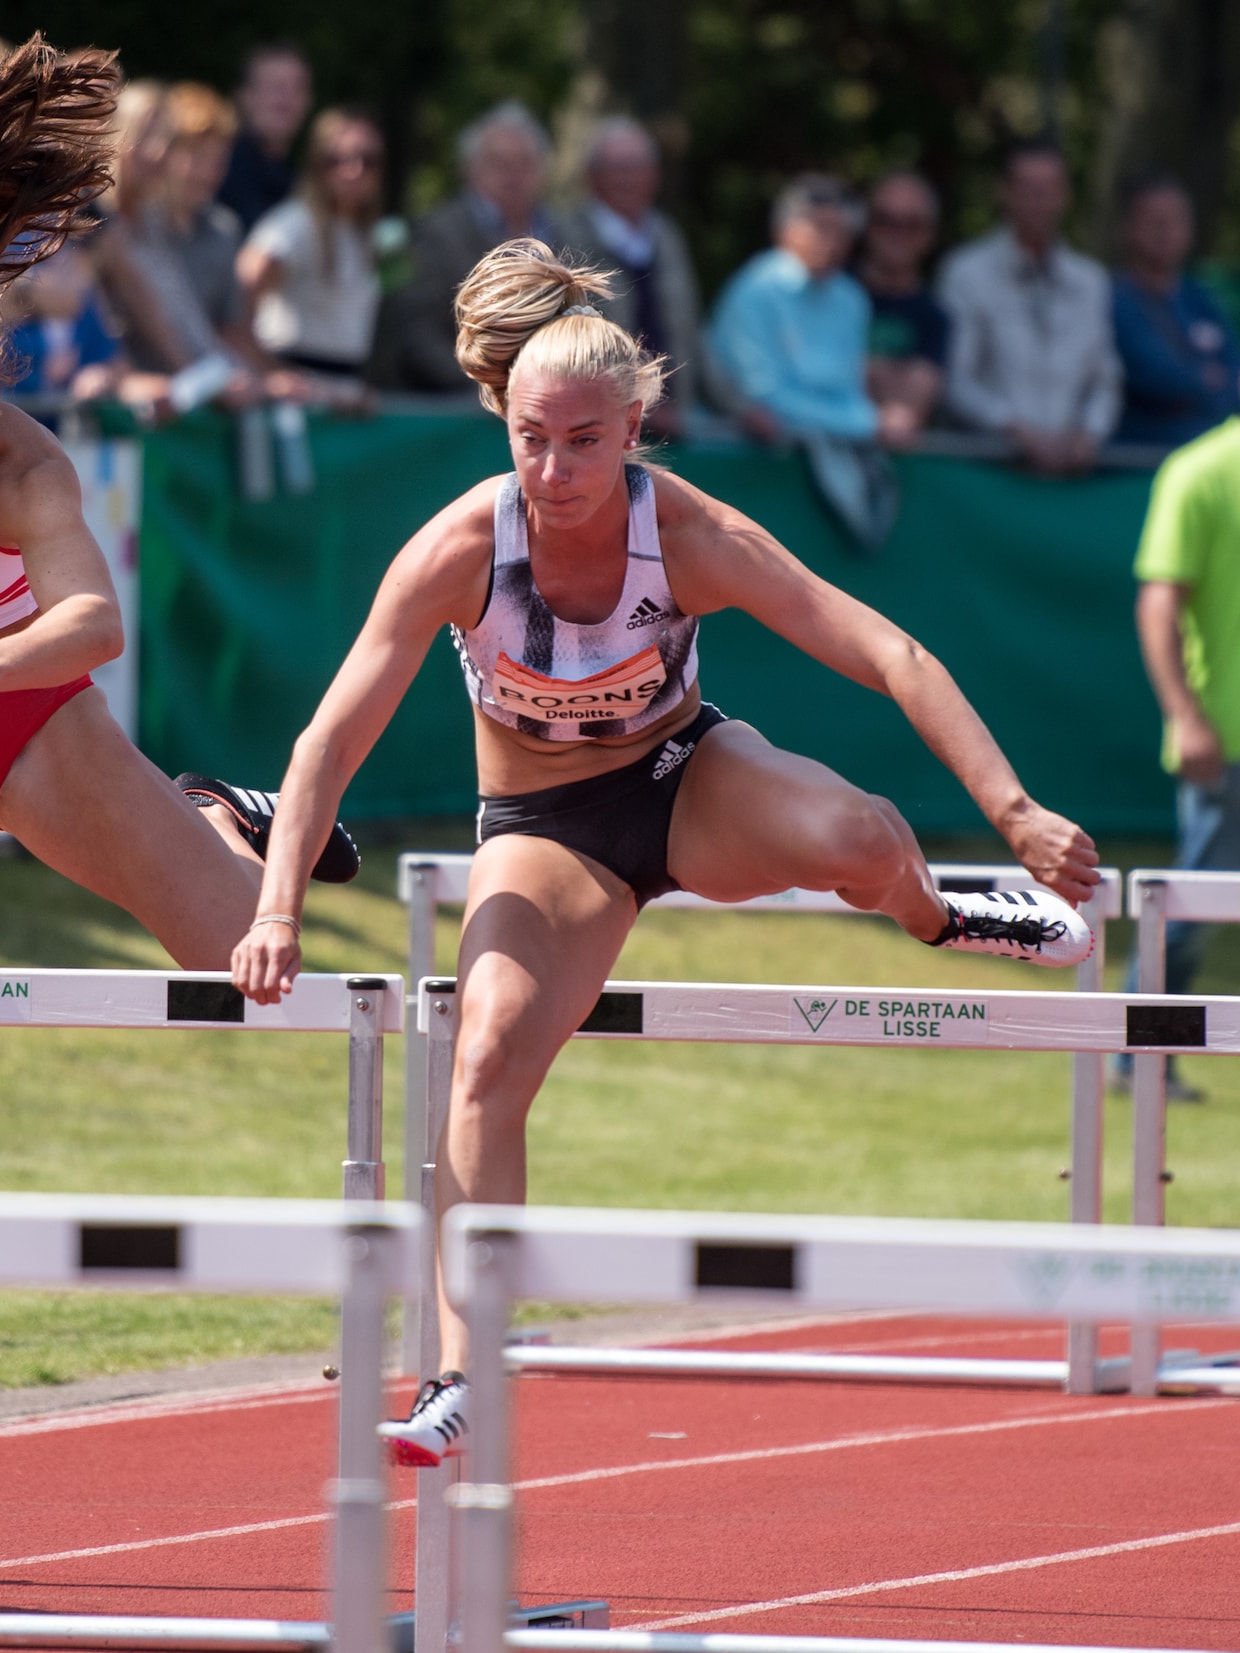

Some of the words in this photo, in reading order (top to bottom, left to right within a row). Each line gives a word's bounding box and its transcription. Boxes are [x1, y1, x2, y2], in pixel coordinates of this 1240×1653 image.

[626, 608, 670, 631] adidas
[499, 679, 661, 708] BOONS
[652, 741, 696, 781] adidas
[845, 1000, 871, 1016] DE
[878, 1001, 985, 1020] SPARTAAN
[883, 1021, 941, 1037] LISSE
